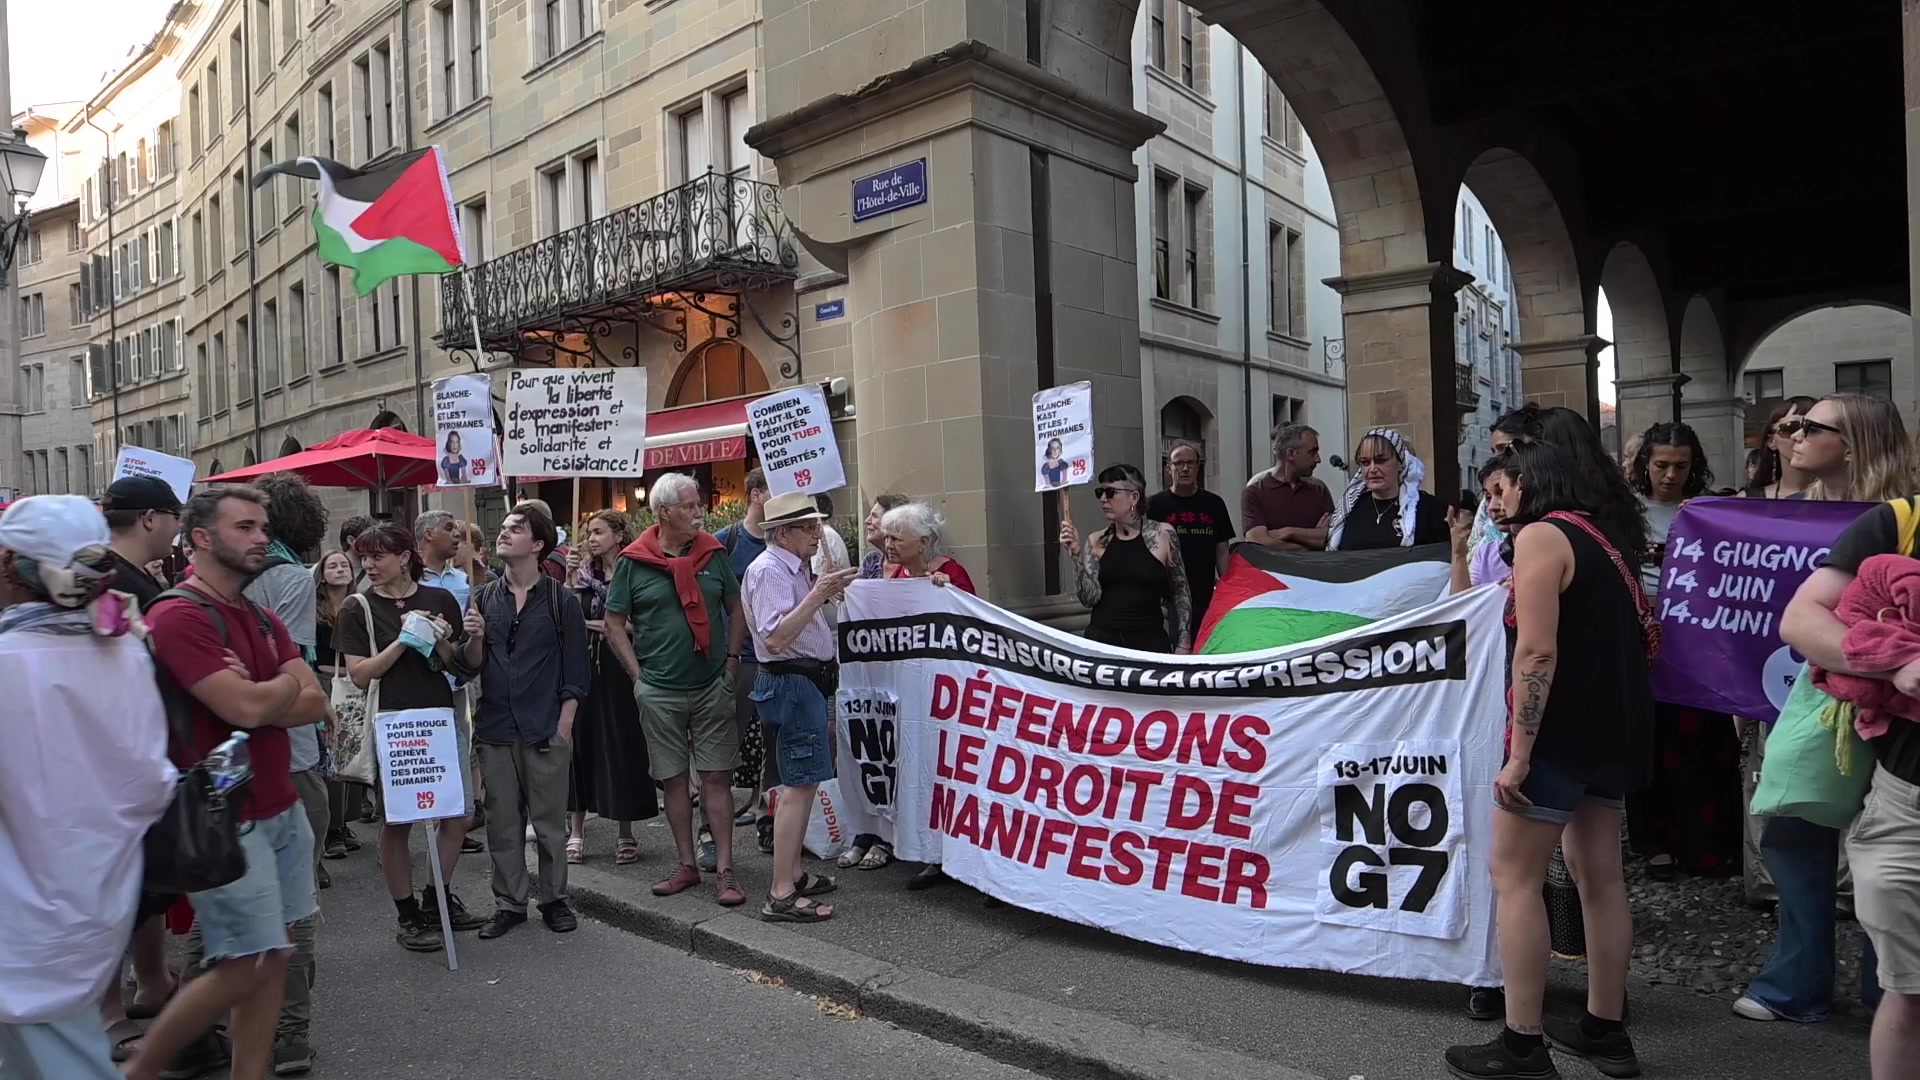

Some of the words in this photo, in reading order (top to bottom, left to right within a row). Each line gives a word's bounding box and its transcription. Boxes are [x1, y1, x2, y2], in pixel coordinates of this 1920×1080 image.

[872, 179, 889, 192] Rue
[891, 172, 902, 186] de
[510, 371, 539, 391] Pour
[542, 374, 565, 395] que
[571, 369, 616, 385] vivent
[436, 389, 472, 401] BLANCHE-
[548, 386, 560, 405] la
[566, 385, 614, 404] liberté
[437, 401, 455, 411] KAST
[508, 402, 600, 427] d'expression
[609, 400, 624, 415] et
[753, 397, 801, 419] COMBIEN
[1036, 398, 1074, 413] BLANCHE-
[437, 413, 446, 421] ET
[446, 411, 460, 420] LES
[461, 410, 466, 418] 7
[756, 411, 795, 430] FAUT-IL
[796, 405, 811, 416] DE
[1036, 411, 1058, 422] KAST
[438, 420, 484, 431] PYROMANES
[508, 420, 526, 440] de
[758, 418, 808, 440] DÉPUTÉS
[1037, 422, 1047, 431] ET
[1047, 418, 1063, 429] LES
[1063, 417, 1069, 426] 7
[1038, 423, 1085, 441] PYROMANES
[519, 436, 588, 455] solidarité
[597, 436, 613, 450] et
[761, 435, 792, 451] POUR
[791, 425, 822, 441] TUER
[651, 448, 675, 466] DE
[678, 440, 732, 462] VILLE
[764, 447, 788, 461] NOS
[767, 449, 818, 472] LIBERTÉS
[818, 446, 826, 456] ?
[124, 457, 147, 466] STOP
[470, 458, 486, 468] NO
[1072, 459, 1086, 470] NO
[134, 466, 162, 476] PROJET
[472, 466, 487, 476] G7
[793, 468, 811, 480] NO
[1072, 467, 1086, 476] G7
[796, 476, 812, 488] G7
[1672, 536, 1705, 564] 14
[1666, 567, 1699, 593] 14
[1707, 573, 1776, 603] JUIN
[1701, 605, 1774, 638] JUNI
[846, 624, 927, 653] CONTRE
[928, 622, 958, 650] LA
[961, 627, 1094, 685] CENSURE
[1095, 664, 1140, 687] ET
[1139, 669, 1184, 688] LA
[385, 721, 415, 730] TAPIS
[416, 720, 448, 728] ROUGE
[929, 669, 1272, 774] DÉFENDONS
[386, 731, 415, 740] POUR
[416, 729, 433, 737] LES
[847, 717, 897, 765] NO
[387, 739, 430, 749] TYRANS,
[389, 748, 428, 758] GENÈVE
[390, 757, 436, 768] CAPITALE
[1334, 756, 1392, 779] 13-17
[1391, 755, 1447, 776] JUIN
[390, 768, 411, 777] DES
[412, 766, 446, 775] DROITS
[391, 777, 436, 787] HUMAINS
[436, 775, 443, 783] ?
[936, 729, 986, 785] LE
[986, 743, 1164, 823] DROIT
[1165, 773, 1260, 840] DE
[416, 791, 435, 801] NO
[417, 800, 435, 810] G7
[816, 790, 842, 844] MIGROS
[1334, 783, 1449, 848] NO
[929, 782, 1271, 909] MANIFESTER
[1329, 844, 1449, 913] G7
